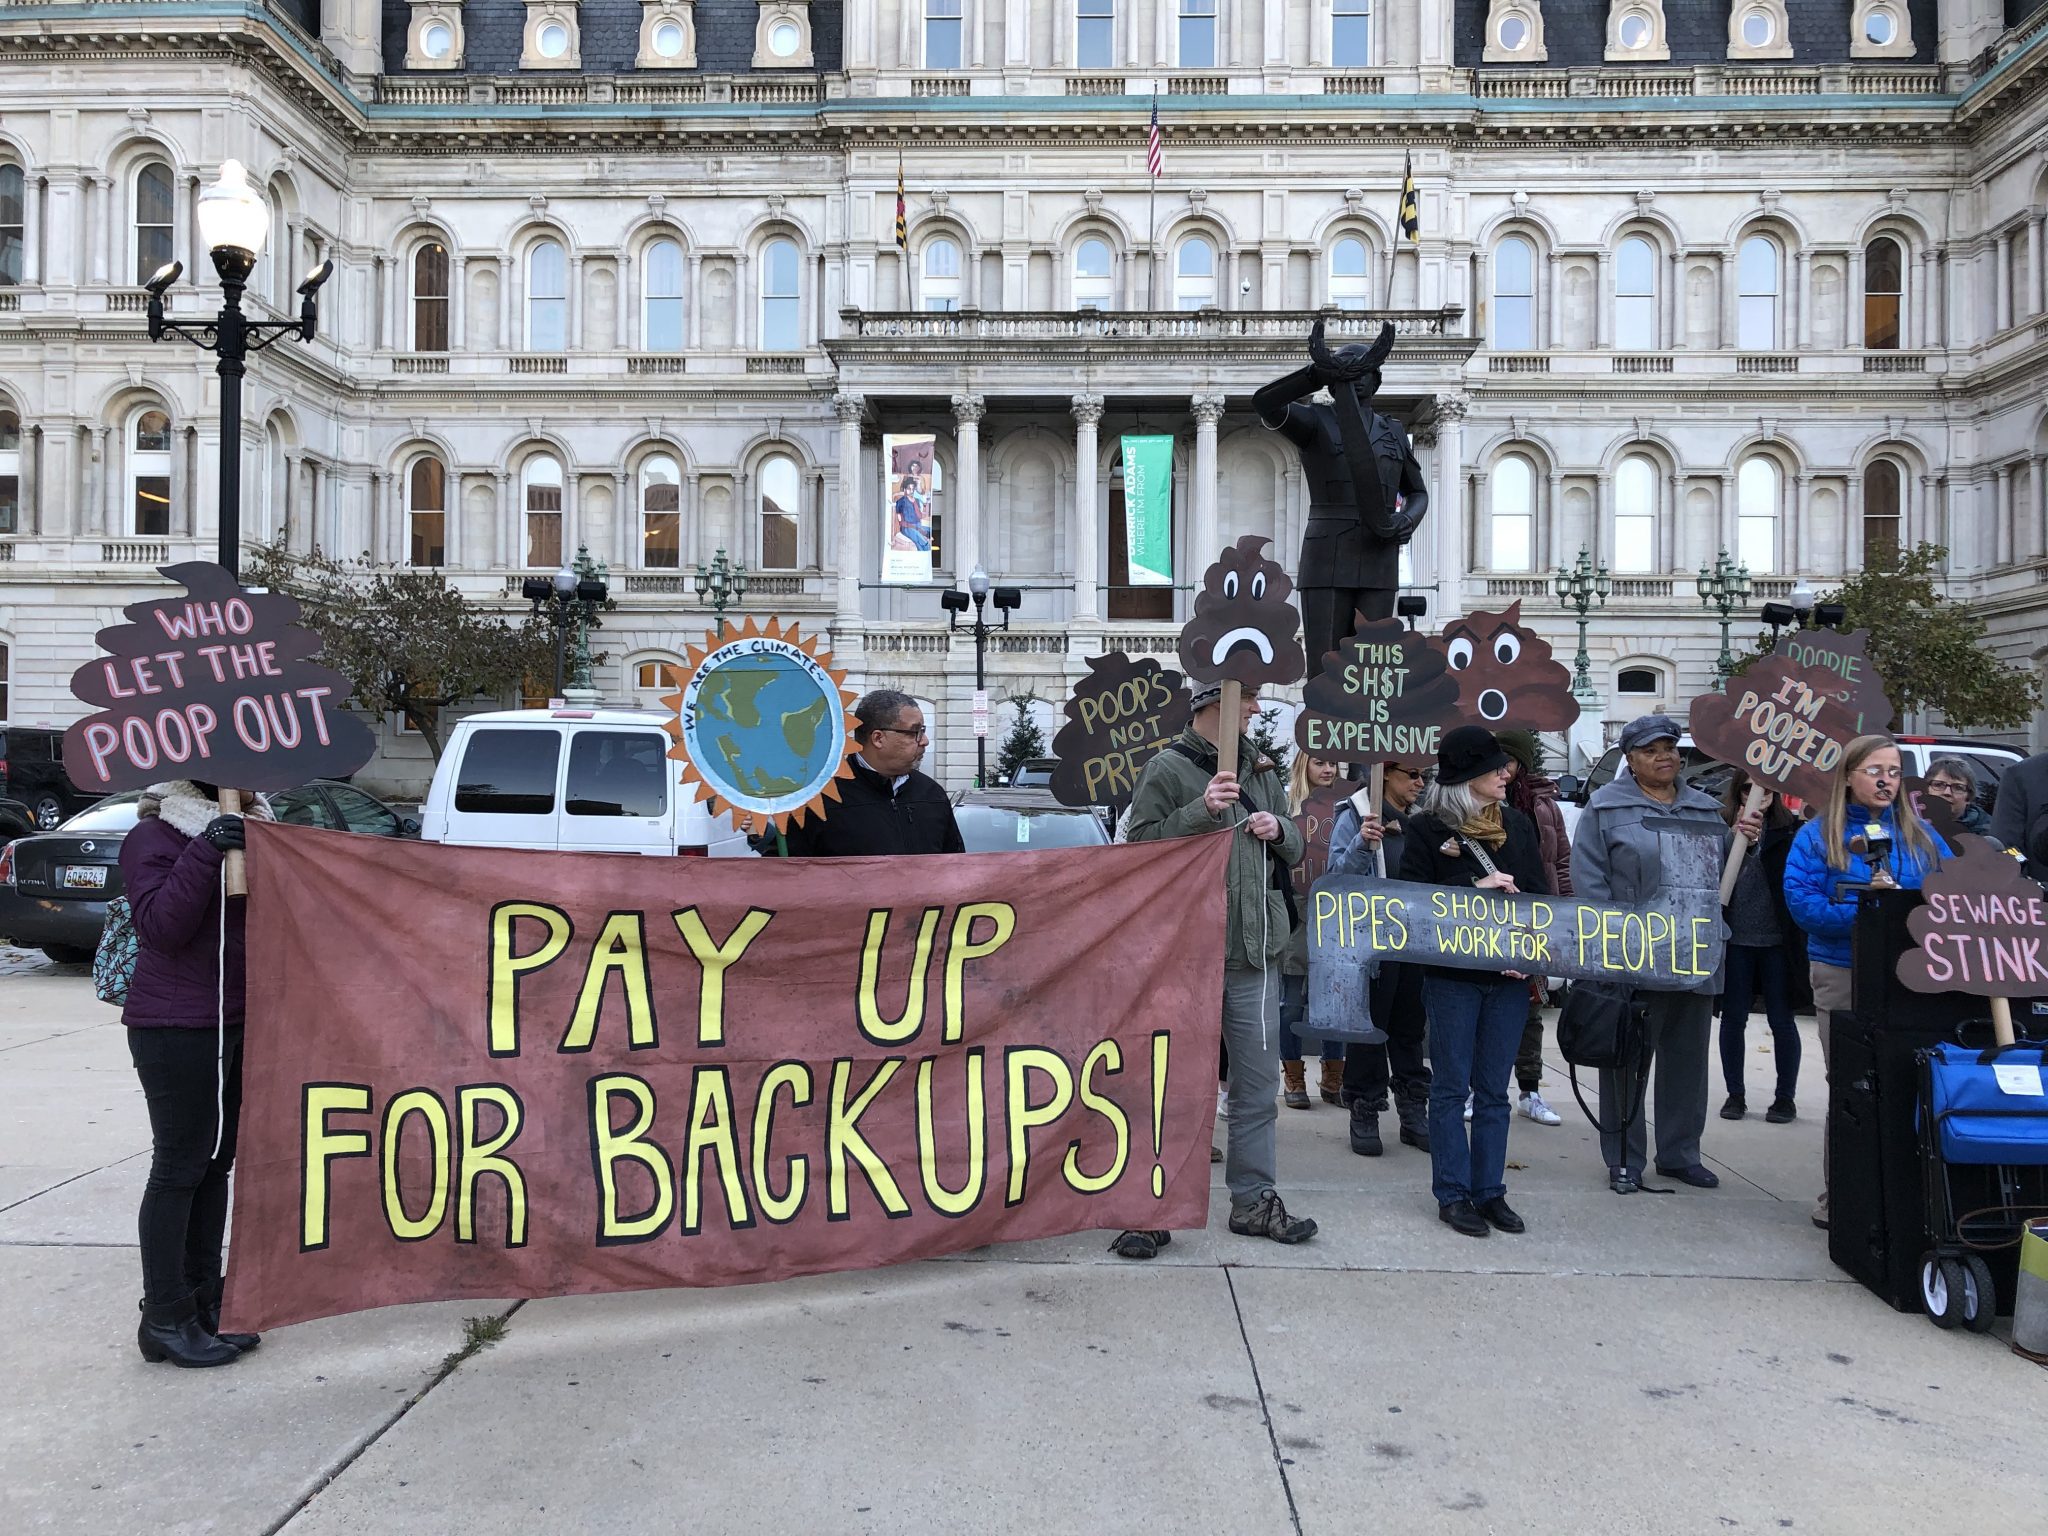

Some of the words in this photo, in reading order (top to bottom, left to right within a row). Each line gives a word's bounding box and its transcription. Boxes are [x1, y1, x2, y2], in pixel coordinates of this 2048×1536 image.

[1126, 446, 1136, 496] ADAMS
[1136, 465, 1146, 496] FROM
[1136, 500, 1145, 514] I'M
[1136, 516, 1145, 556] WHERE
[154, 597, 253, 641] WHO
[104, 651, 185, 699] LET
[198, 641, 282, 682] THE
[1354, 643, 1404, 665] THIS
[1788, 641, 1863, 683] DOODIE
[685, 701, 697, 731] WE
[691, 663, 712, 691] ARE
[712, 643, 742, 664] THE
[750, 640, 821, 675] CLIMATE
[1079, 668, 1172, 735] POOP'S
[1343, 664, 1410, 699] SH$T
[1771, 675, 1827, 721] I'M
[1110, 715, 1162, 749] NOT
[1370, 699, 1390, 723] IS
[1734, 690, 1843, 772] POOPED
[83, 703, 218, 782] POOP
[233, 686, 331, 753] OUT
[1308, 718, 1442, 755] EXPENSIVE
[1083, 733, 1183, 802] PRET
[1746, 738, 1802, 783] OUT
[1315, 891, 1409, 952] PIPES
[1431, 891, 1554, 931] SHOULD
[1928, 893, 2047, 926] SEWAGE
[1436, 925, 1504, 959] WORK
[1510, 930, 1552, 962] FOR
[1577, 905, 1712, 976] PEOPLE
[1924, 932, 2048, 982] STINK
[487, 899, 777, 1058] PAY
[854, 901, 1018, 1048] UP
[299, 1081, 529, 1254] FOR
[586, 1029, 1171, 1248] BACKUPS!
